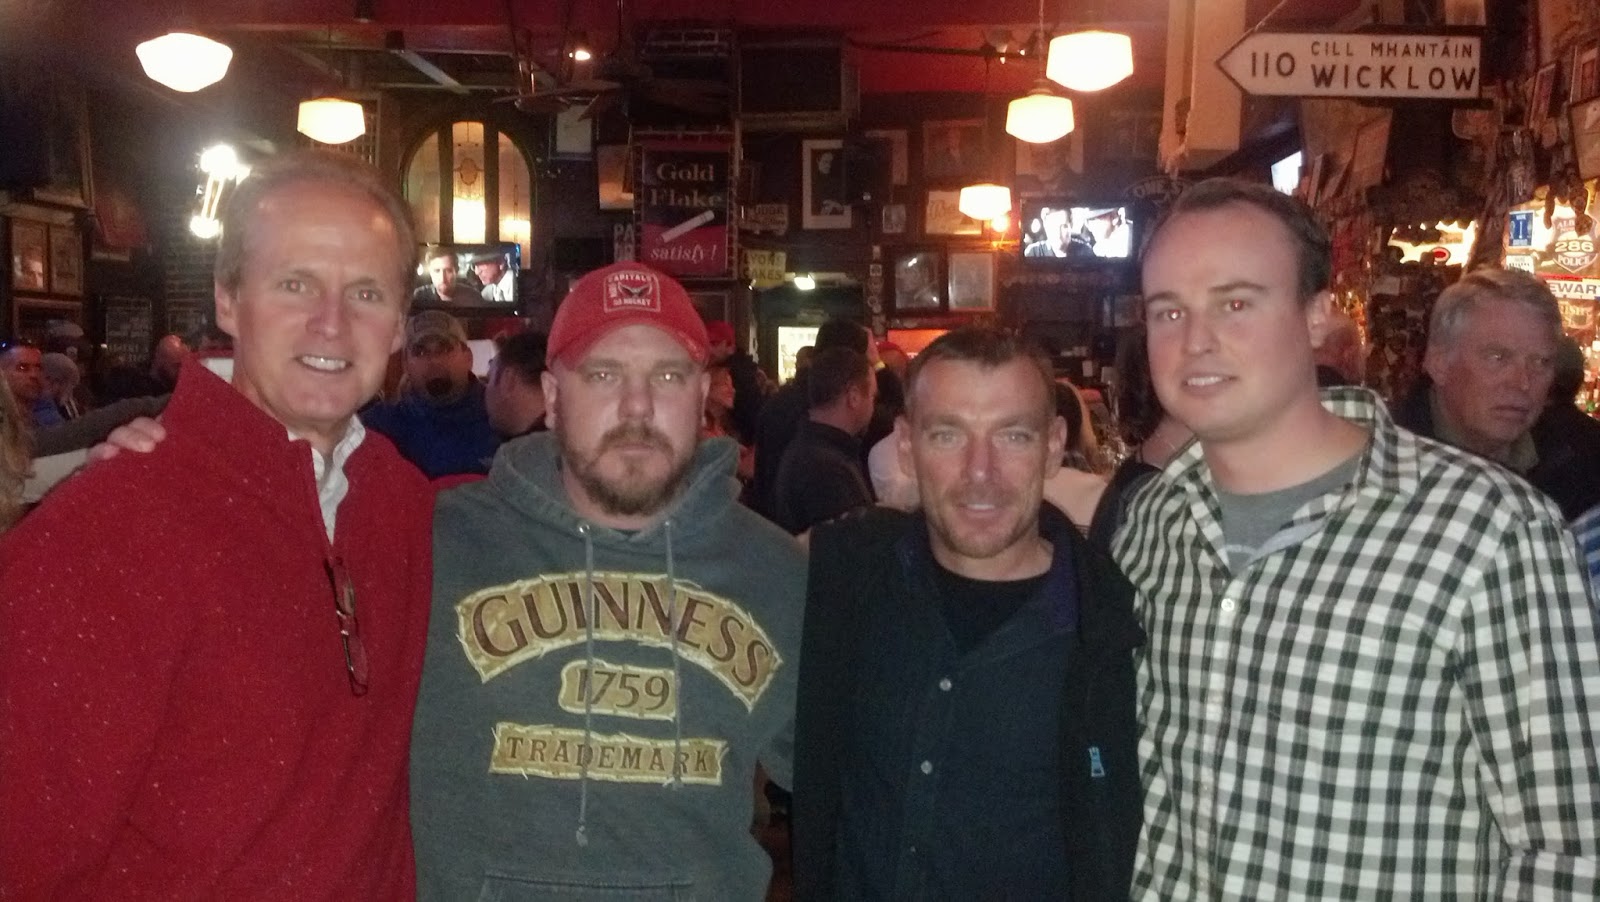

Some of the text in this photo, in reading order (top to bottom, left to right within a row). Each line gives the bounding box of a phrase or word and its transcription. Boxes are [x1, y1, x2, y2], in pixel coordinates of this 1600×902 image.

[1310, 39, 1473, 59] CILL MHANTÁIN
[1251, 51, 1296, 78] 110
[1310, 64, 1476, 91] WICKLOW
[656, 162, 715, 182] Gold
[650, 189, 722, 207] Flake
[1554, 240, 1594, 252] 286
[1557, 254, 1590, 267] POLICE
[1549, 282, 1600, 295] EWAR
[472, 580, 769, 687] GUINNESS
[577, 668, 671, 711] 1759
[506, 736, 711, 774] TRADEMARK
